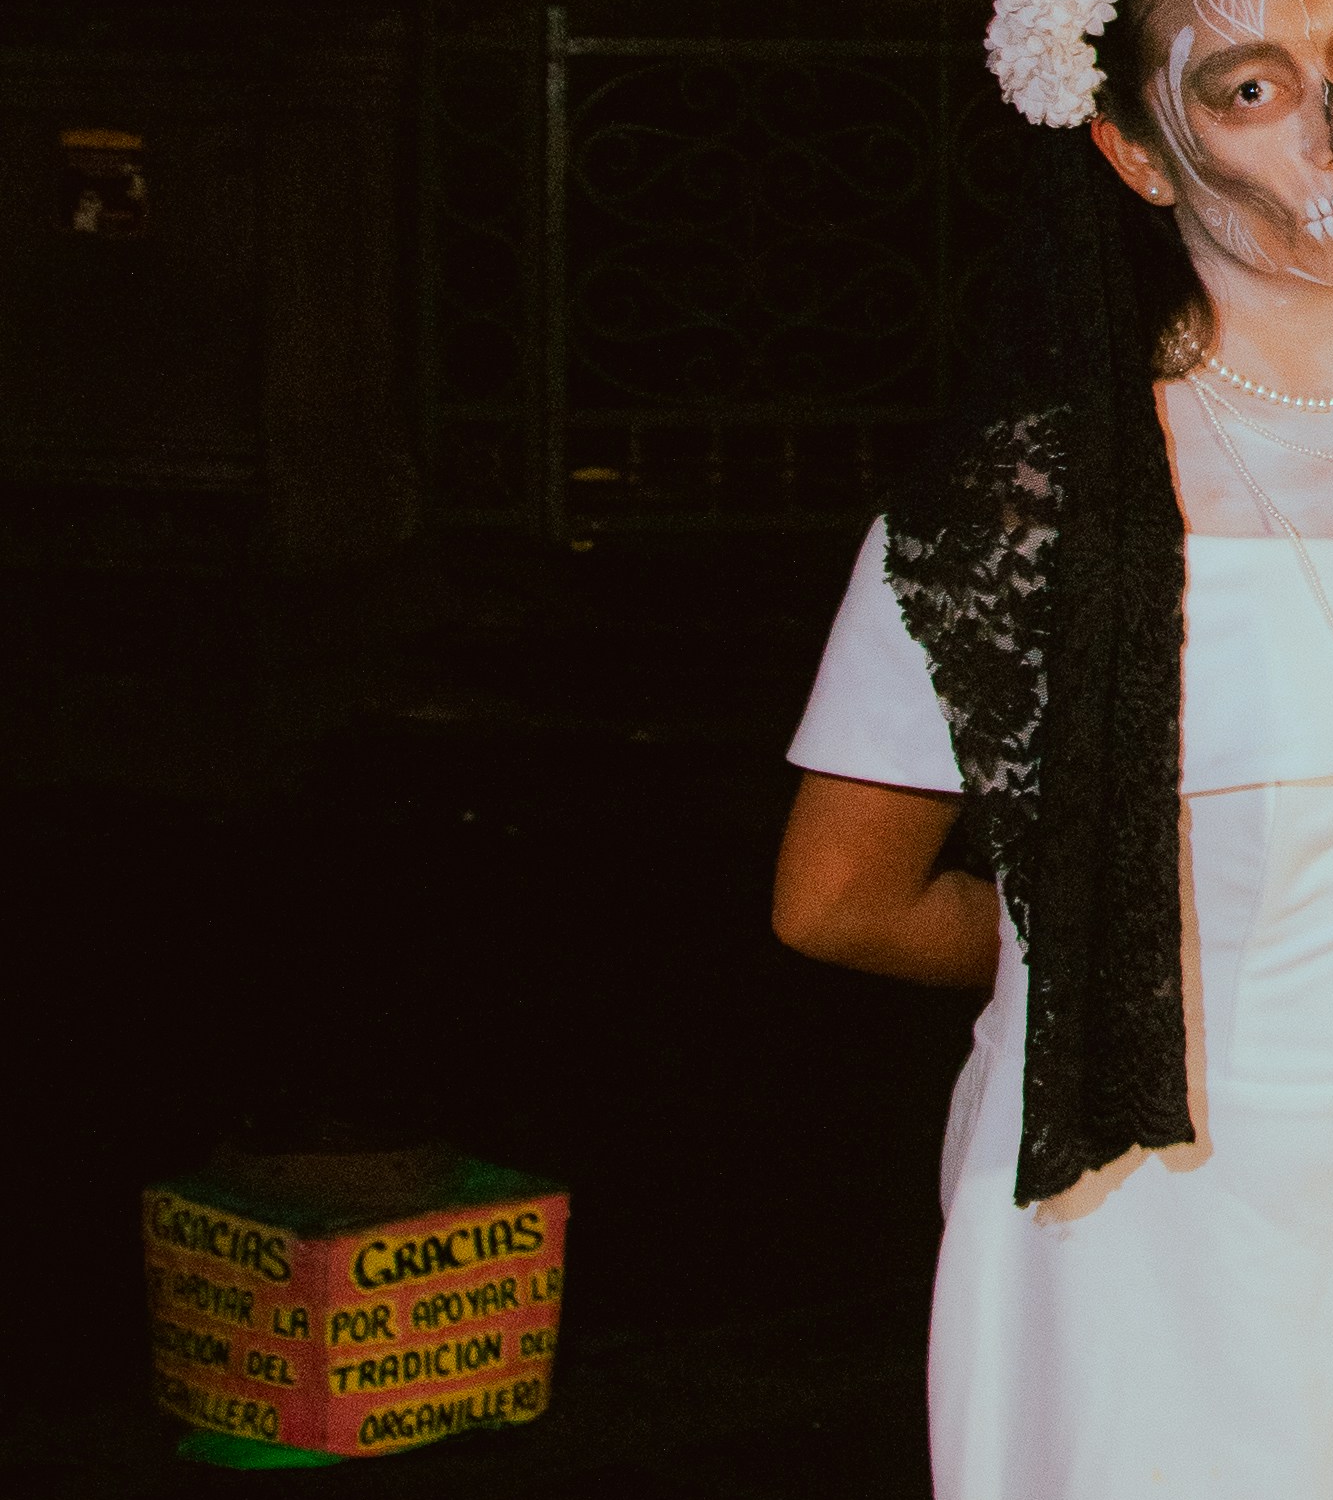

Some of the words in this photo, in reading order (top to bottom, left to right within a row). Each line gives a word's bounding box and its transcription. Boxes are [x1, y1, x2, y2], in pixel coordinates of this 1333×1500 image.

[152, 1197, 292, 1282] GRACIAS
[353, 1211, 544, 1290] GRACIAS
[273, 1306, 310, 1338] LA
[330, 1304, 396, 1345] POR
[411, 1277, 519, 1330] APOYAR
[247, 1349, 295, 1387] DEL
[332, 1333, 502, 1392] TRADICION
[358, 1377, 542, 1447] ORGANILLERO
